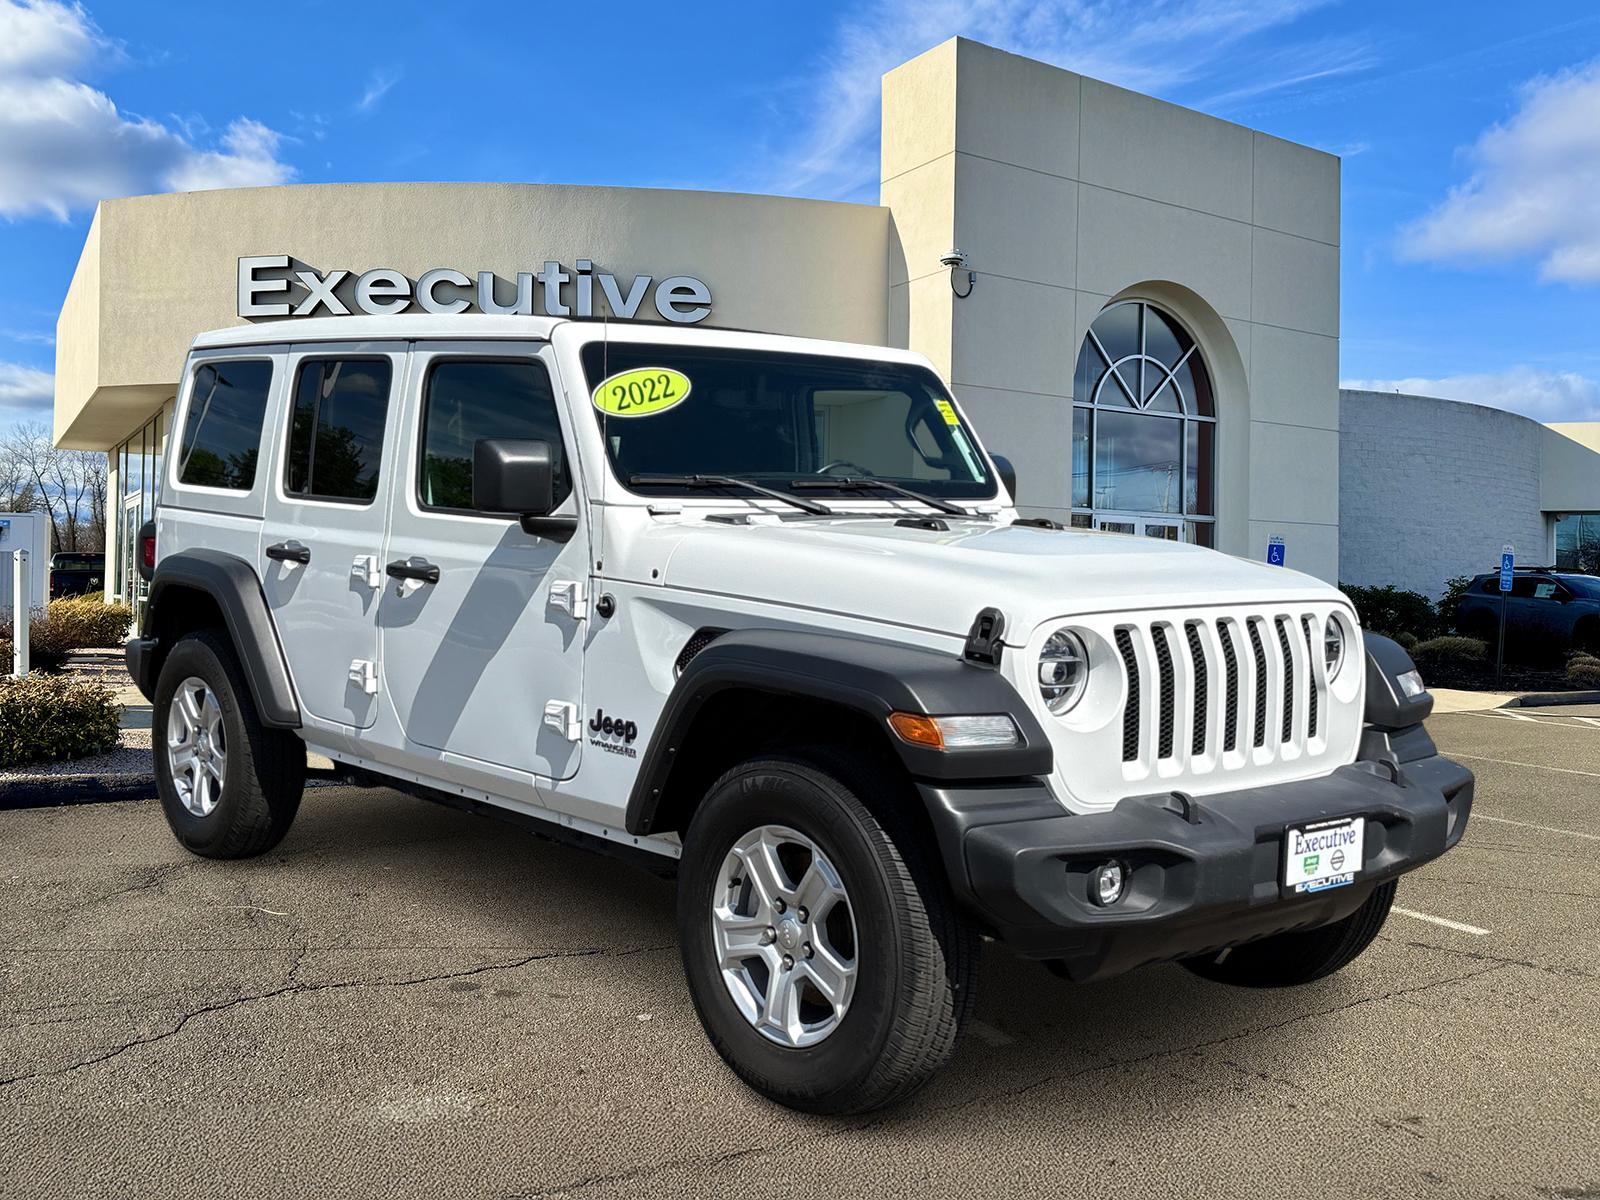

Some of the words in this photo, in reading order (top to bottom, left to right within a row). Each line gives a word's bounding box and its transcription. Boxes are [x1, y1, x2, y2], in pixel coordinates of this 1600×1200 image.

[237, 255, 713, 323] Executive
[612, 374, 675, 411] 2022
[589, 708, 638, 744] Jeep
[1294, 829, 1356, 855] Executive
